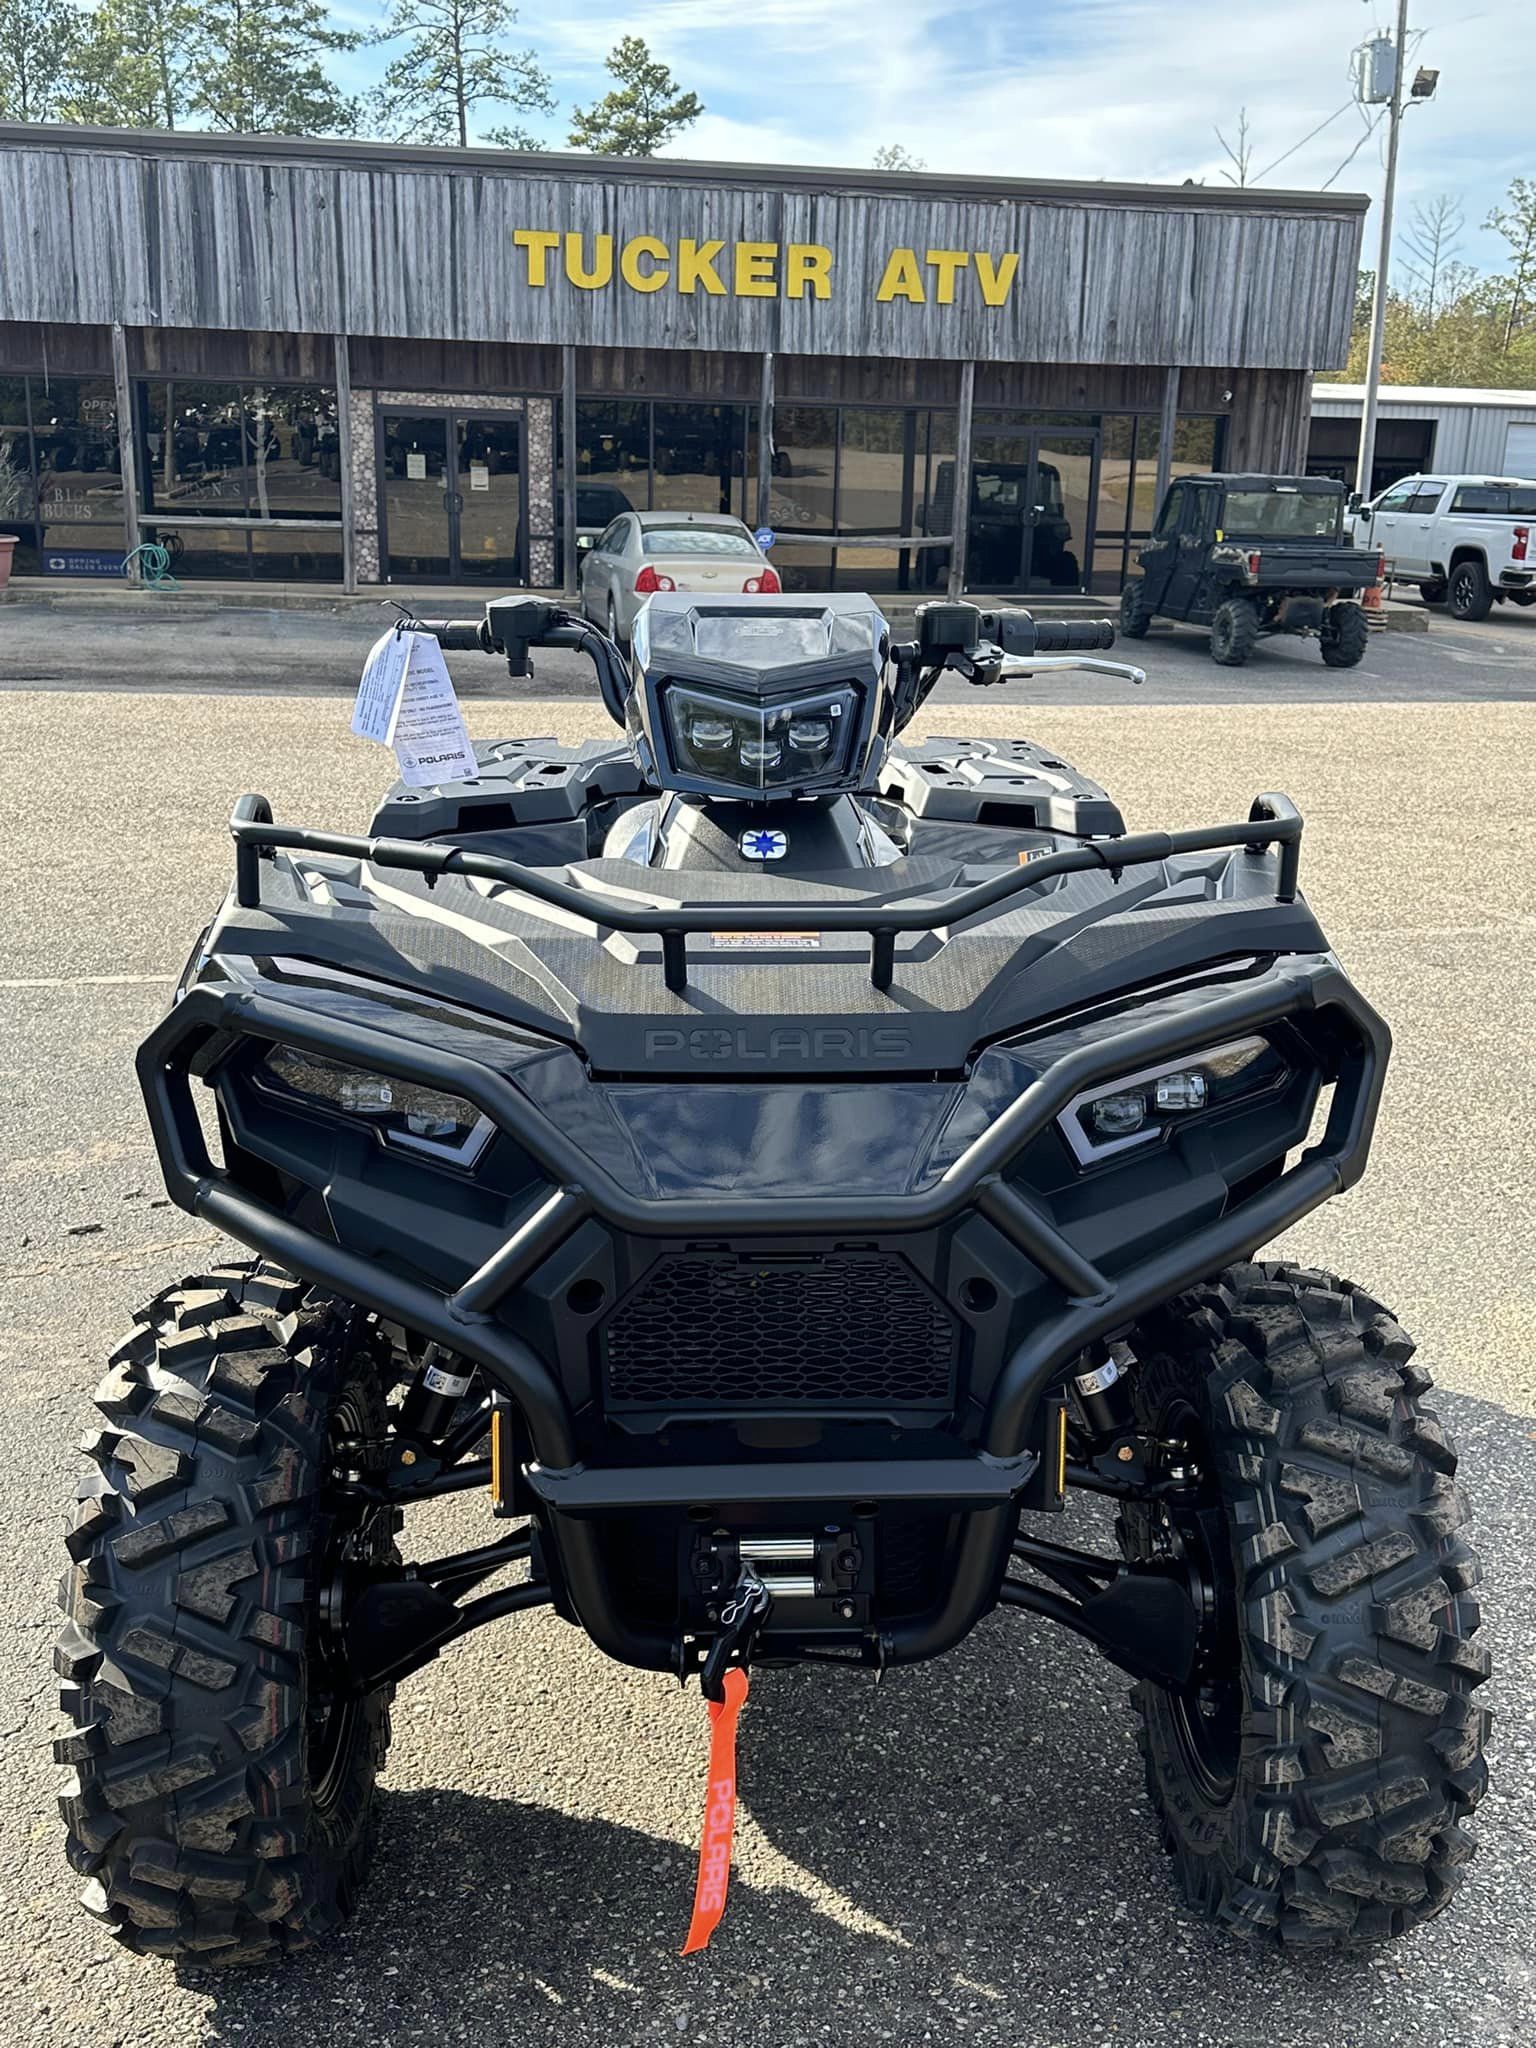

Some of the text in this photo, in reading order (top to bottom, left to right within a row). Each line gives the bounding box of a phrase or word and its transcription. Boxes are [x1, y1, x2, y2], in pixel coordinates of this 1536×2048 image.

[513, 230, 1019, 306] TUCKER ATV
[81, 400, 117, 411] OPEN
[418, 751, 466, 765] POLARIS
[644, 1028, 912, 1060] POLARIS
[700, 1778, 733, 1912] POLARIS
